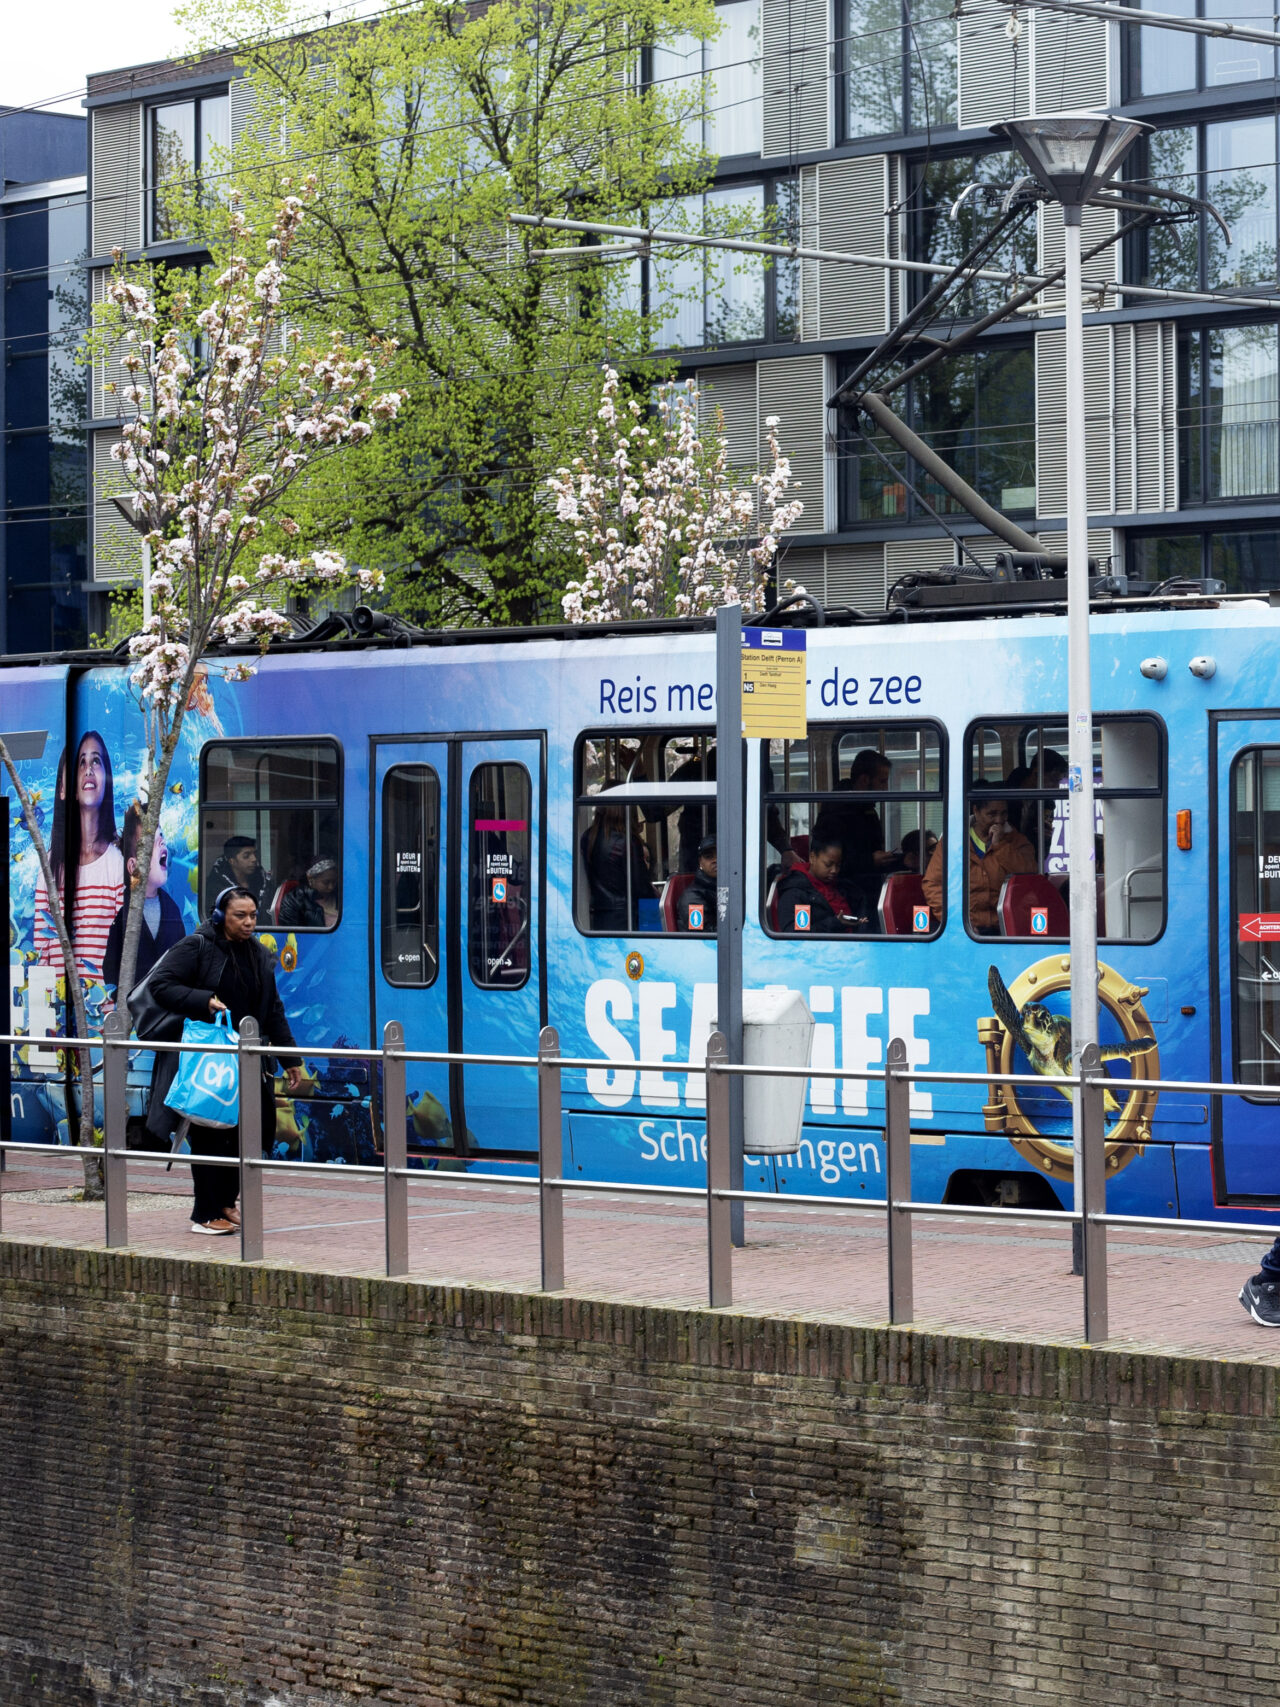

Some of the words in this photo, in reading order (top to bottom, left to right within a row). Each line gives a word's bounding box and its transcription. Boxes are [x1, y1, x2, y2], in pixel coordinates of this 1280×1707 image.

[599, 676, 657, 714] Reis
[667, 681, 718, 712] me
[820, 667, 859, 706] de
[869, 674, 922, 705] zee
[405, 954, 420, 962] open
[487, 958, 504, 966] open
[638, 1120, 881, 1184] Schngen
